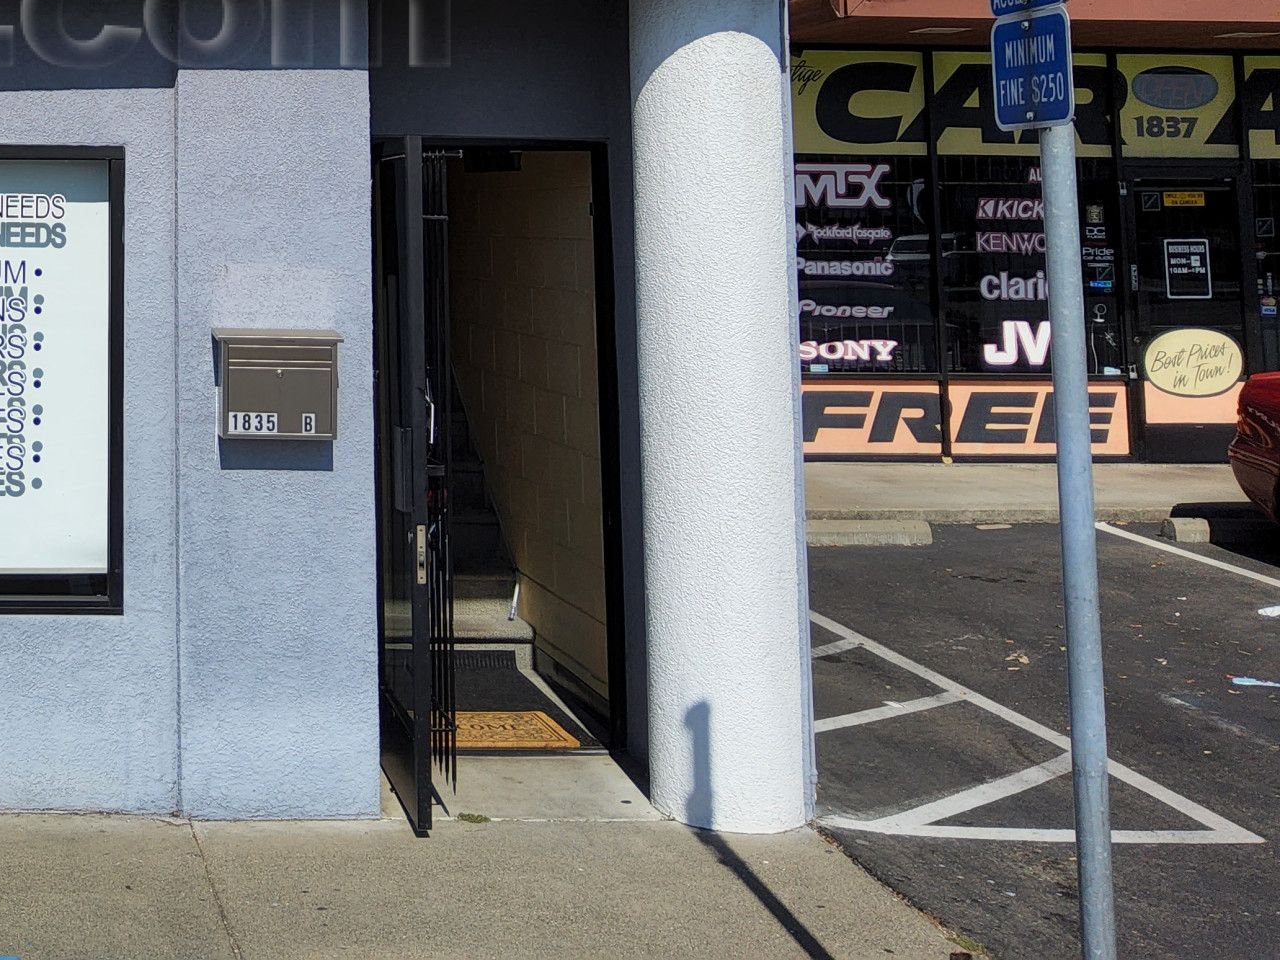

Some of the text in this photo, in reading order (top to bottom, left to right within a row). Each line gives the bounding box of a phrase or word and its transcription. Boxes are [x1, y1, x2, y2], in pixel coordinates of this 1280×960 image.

[1005, 34, 1055, 68] MINIMUM
[1000, 72, 1064, 107] FINE $250
[1133, 116, 1199, 138] 1837
[795, 163, 891, 208] MTX
[797, 256, 894, 276] Panasonic
[799, 299, 894, 318] Pioneer
[800, 339, 898, 361] SONY
[1151, 342, 1229, 373] Best Prices
[1173, 371, 1189, 389] in
[232, 413, 313, 432] 1835 B
[802, 390, 1118, 443] FREE
